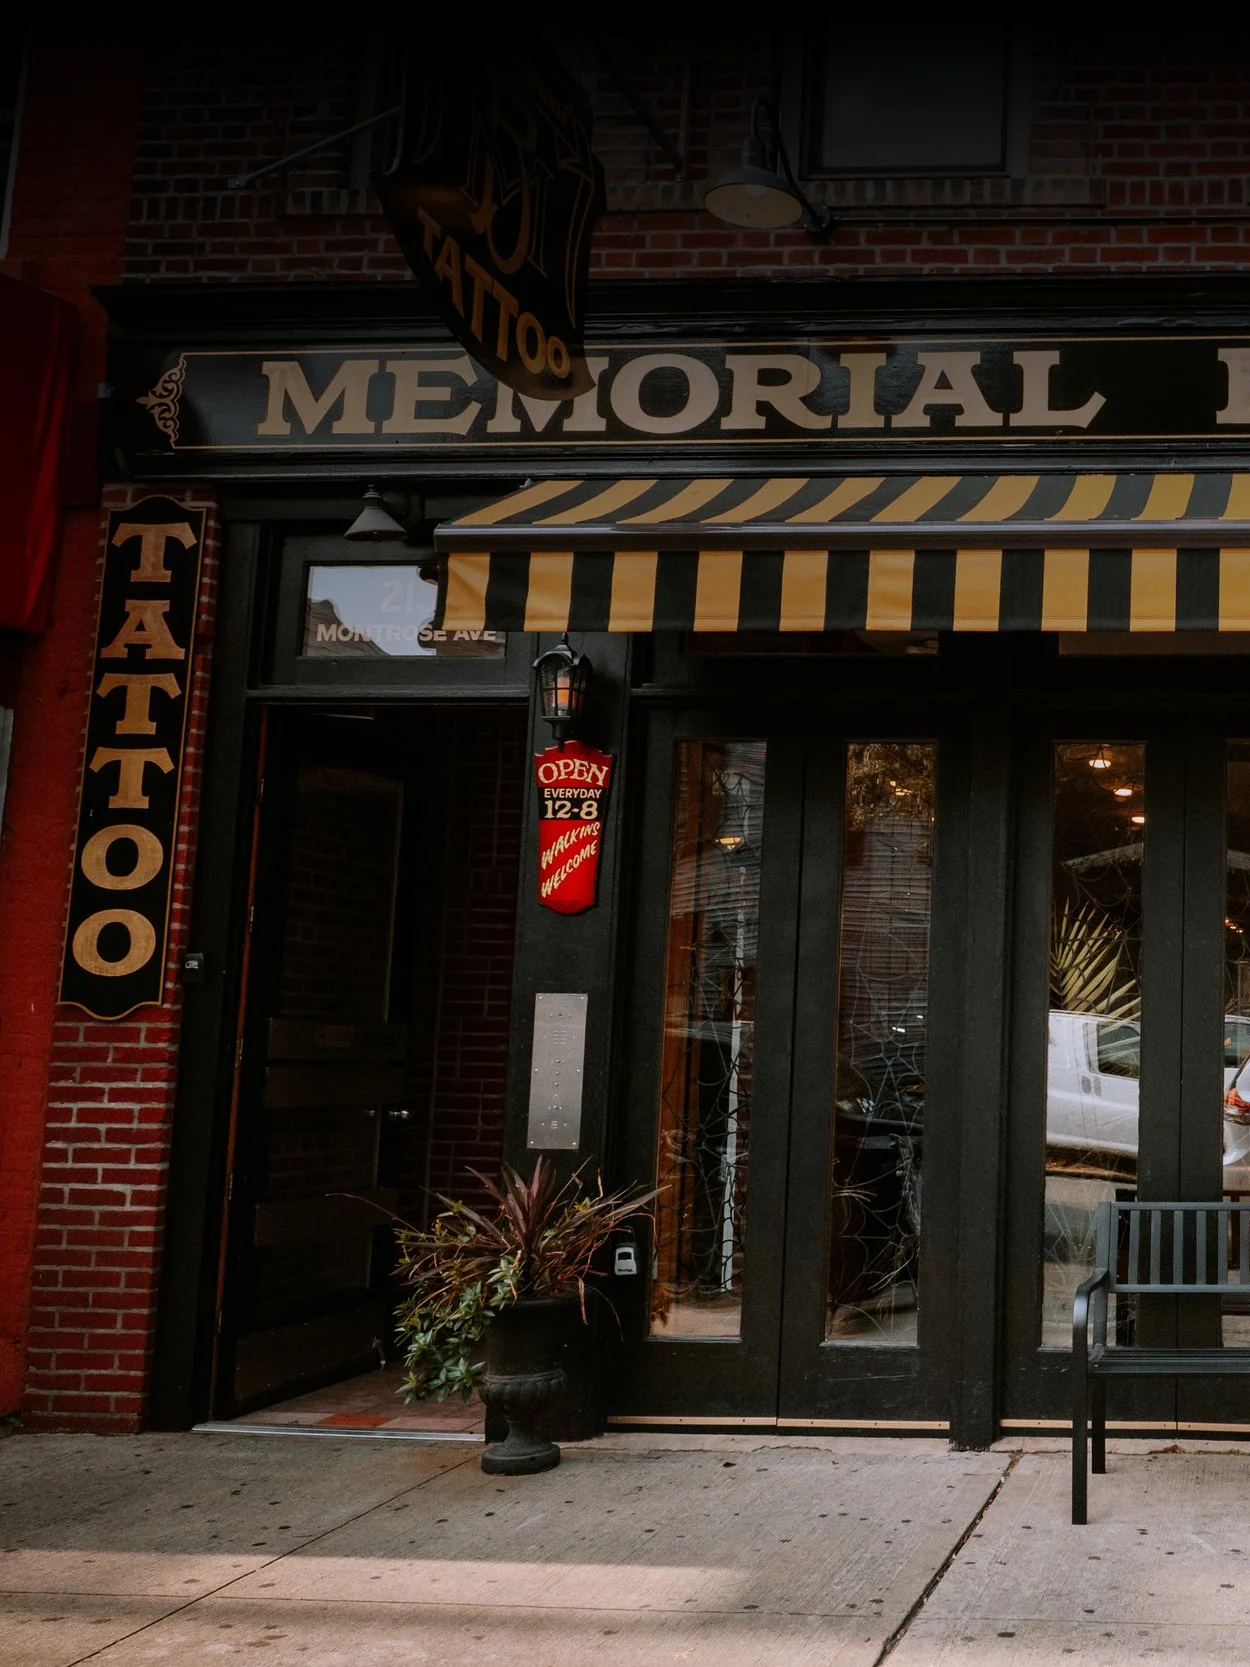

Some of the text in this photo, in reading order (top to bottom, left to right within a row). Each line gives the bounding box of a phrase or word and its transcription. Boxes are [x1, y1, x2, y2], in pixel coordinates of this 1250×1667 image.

[417, 205, 571, 380] TATTOO
[256, 349, 1107, 437] MEMORIAL
[316, 623, 447, 642] MONTROSE
[72, 522, 198, 977] TATTOO
[538, 758, 609, 786] OPEN
[544, 788, 602, 799] EVERYDAY
[544, 800, 599, 820] 12-8
[541, 839, 598, 898] WELCOME
